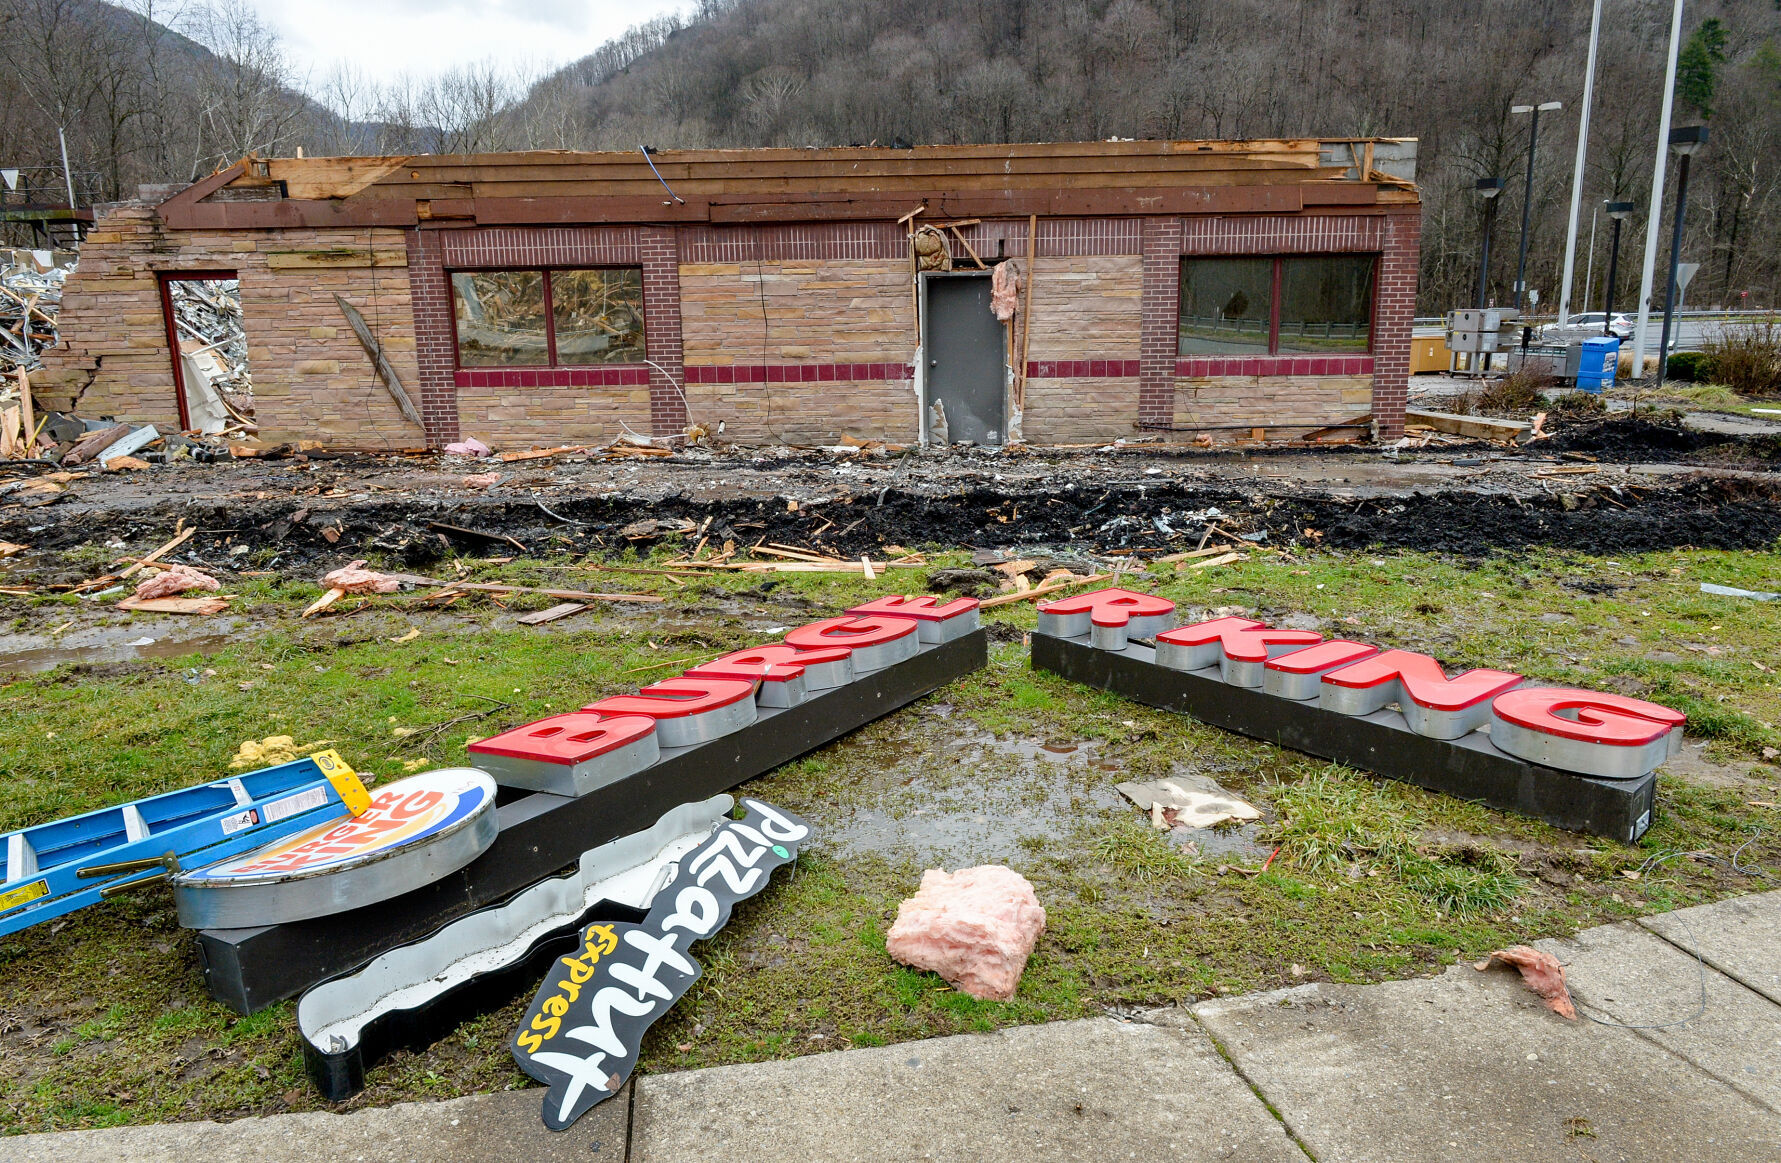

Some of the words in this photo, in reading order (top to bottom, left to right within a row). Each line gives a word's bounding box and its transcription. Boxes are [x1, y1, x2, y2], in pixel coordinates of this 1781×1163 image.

[1155, 616, 1686, 750] KING
[230, 791, 403, 872] BURGER
[266, 790, 444, 872] KING
[662, 798, 810, 935] Pizza
[517, 924, 619, 1054] Express
[530, 929, 695, 1122] Hut
